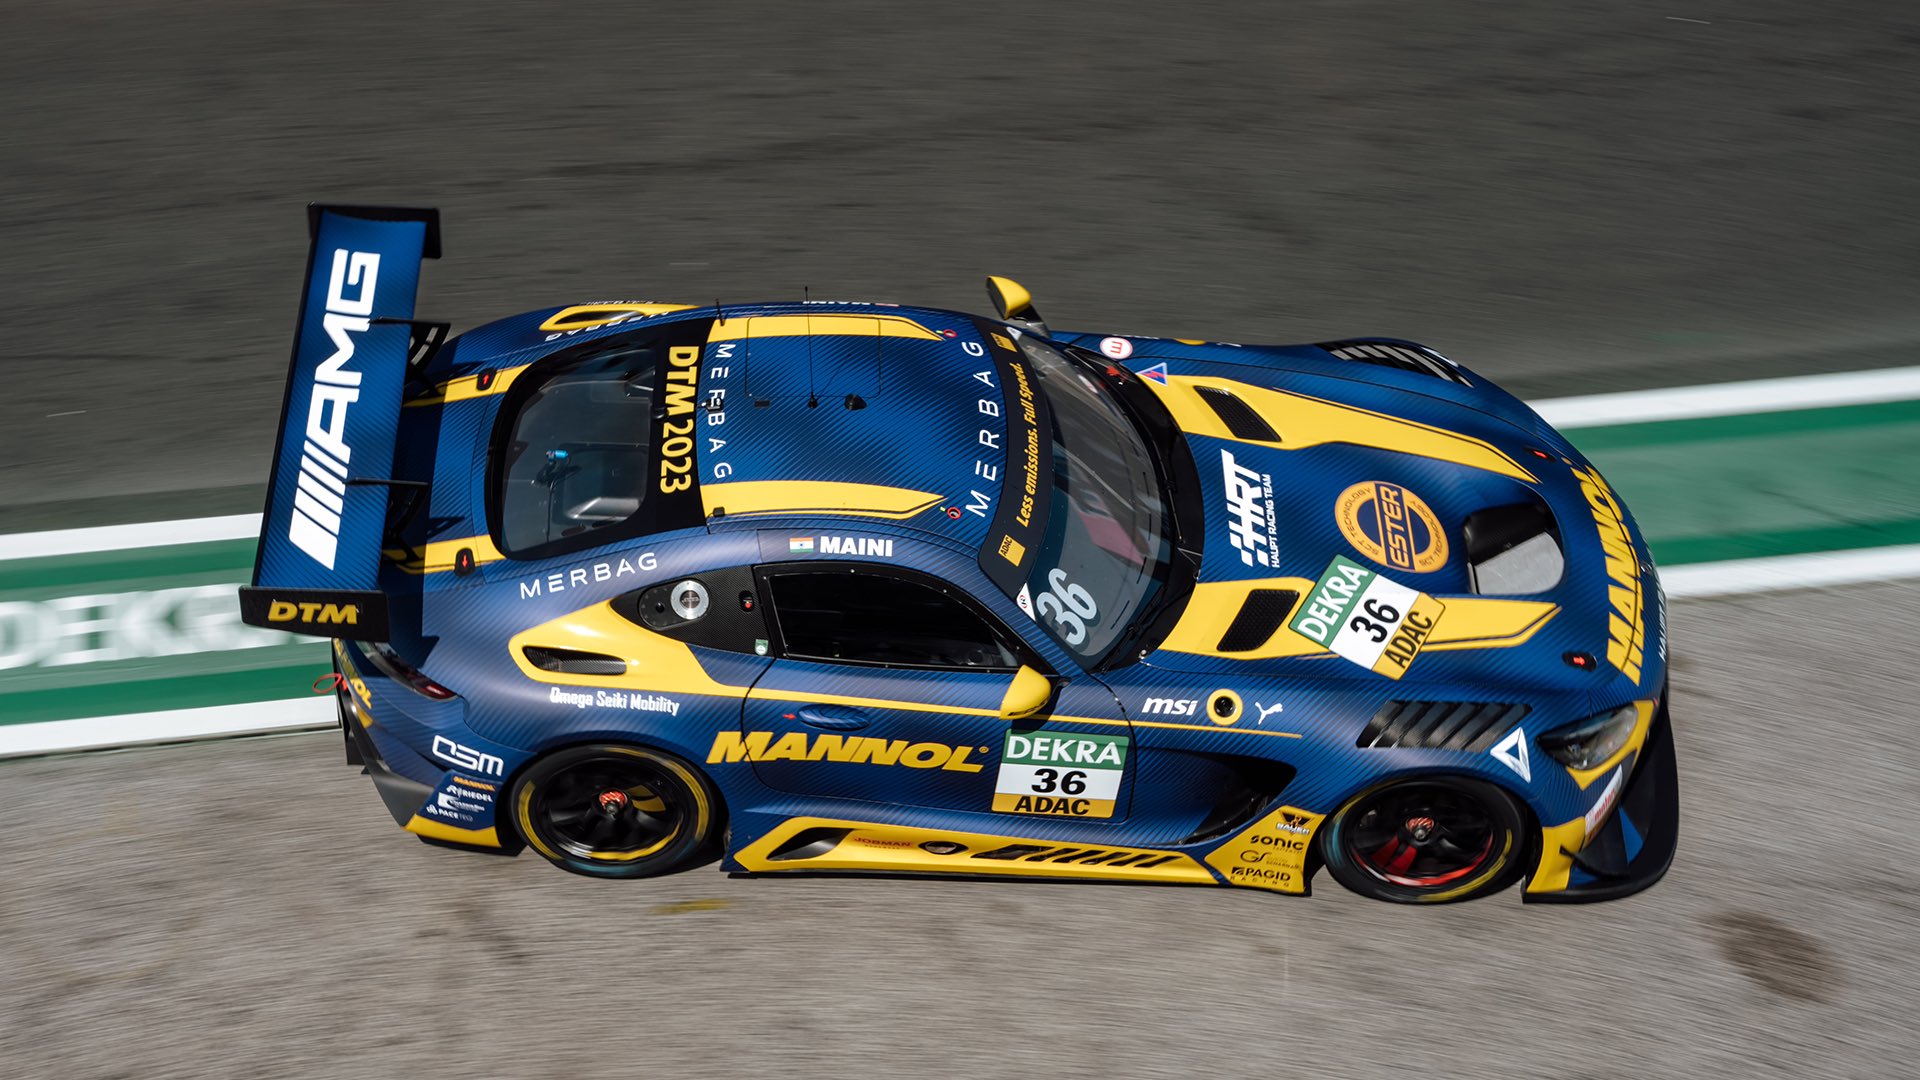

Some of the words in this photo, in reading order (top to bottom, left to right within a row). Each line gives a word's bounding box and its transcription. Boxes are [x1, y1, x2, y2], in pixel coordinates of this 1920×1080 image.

[664, 346, 700, 416] DTM
[707, 343, 737, 479] MERBAG
[962, 341, 1000, 518] MERBAG
[1020, 398, 1037, 426] Full
[659, 418, 695, 494] 2023
[1023, 428, 1039, 495] emissions.
[1261, 473, 1274, 499] TEAM
[1016, 494, 1033, 529] Less
[1265, 501, 1277, 535] RACING
[1379, 485, 1410, 568] ESTER
[820, 535, 893, 557] MAINI
[1000, 537, 1013, 556] ADAC
[1268, 535, 1280, 568] HAUPT
[519, 552, 658, 600] MERBAG
[1570, 464, 1645, 688] MANNOL
[268, 601, 358, 625] DTM
[1036, 568, 1097, 645] 36
[1297, 564, 1370, 643] DEKRA
[1350, 598, 1400, 643] 36
[0, 583, 331, 670] DEKR
[1384, 610, 1433, 669] ADAC
[549, 686, 594, 709] Omega
[596, 690, 628, 709] Seiki
[629, 693, 680, 717] Mobility
[1006, 736, 1122, 765] DEKRA
[1031, 768, 1088, 796] 36
[1014, 796, 1090, 815] ADAC
[1245, 867, 1291, 882] PAGID
